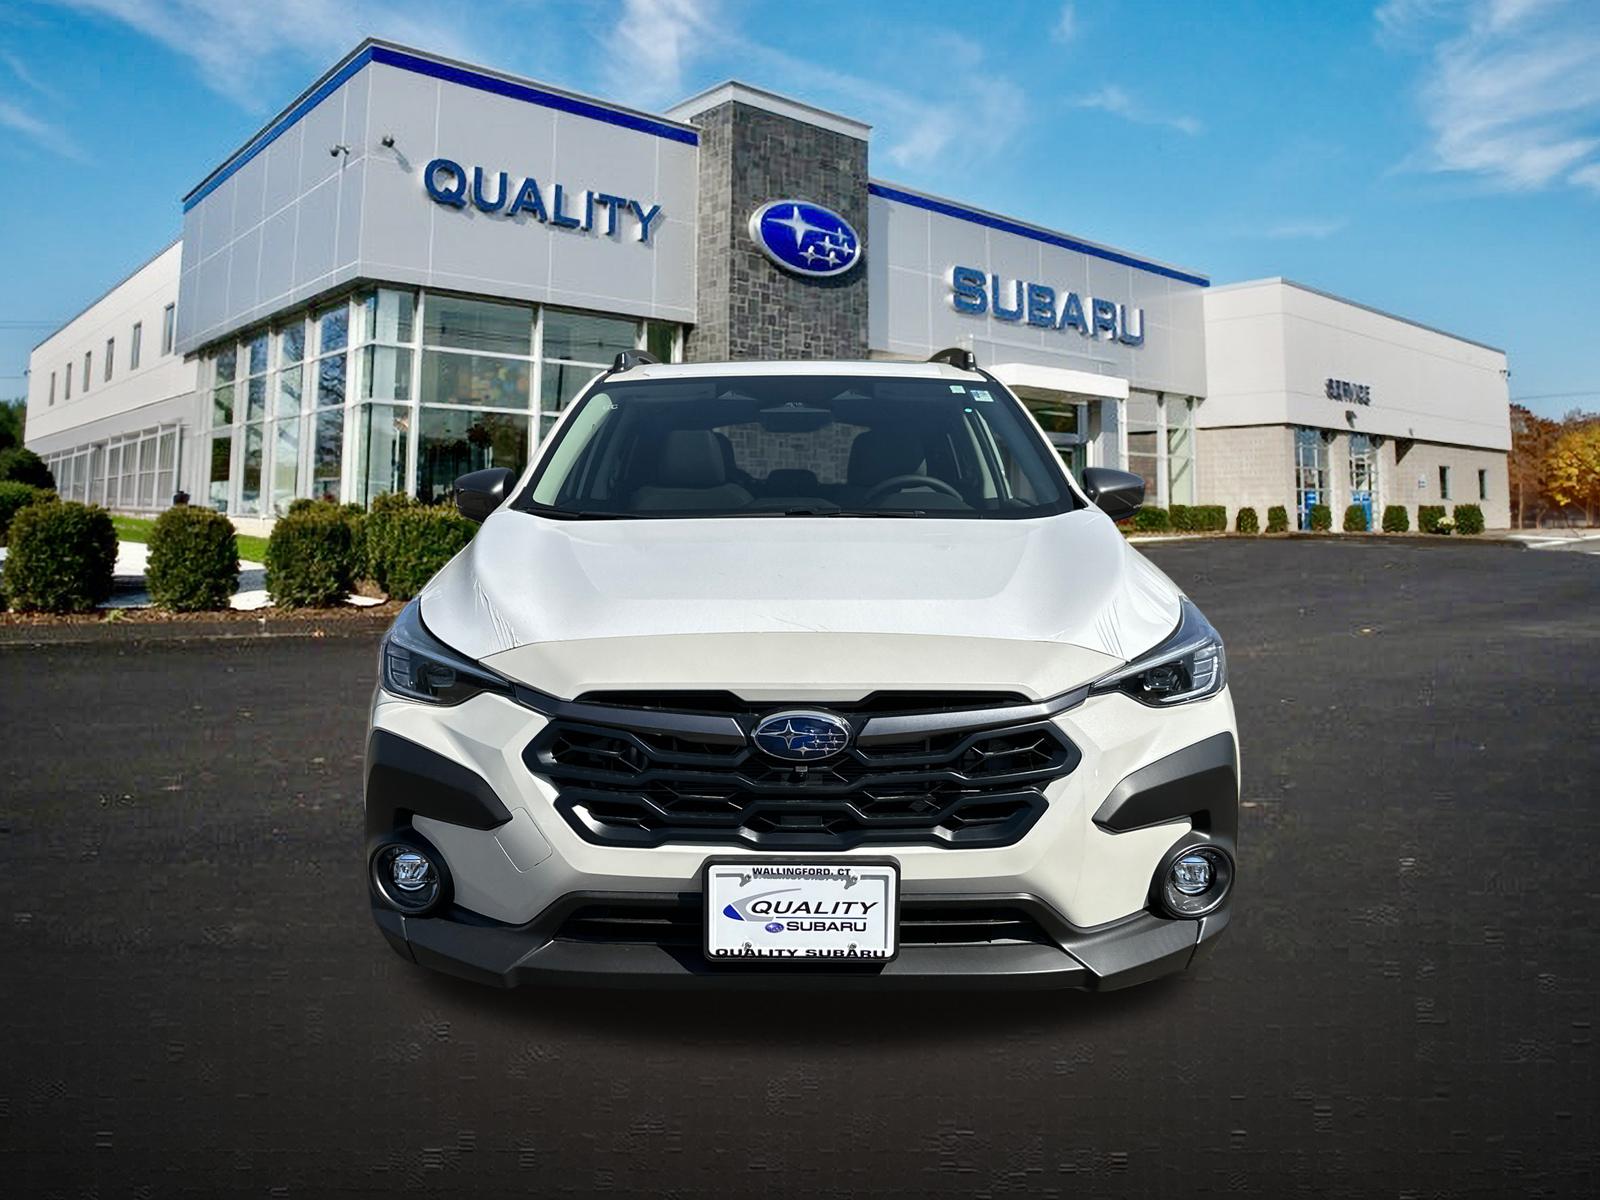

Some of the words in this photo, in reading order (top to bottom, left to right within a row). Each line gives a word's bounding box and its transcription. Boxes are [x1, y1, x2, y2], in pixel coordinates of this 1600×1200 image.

[424, 158, 661, 243] QUALITY
[953, 265, 1145, 347] SUBARU
[837, 868, 851, 876] CT
[751, 900, 879, 915] QUALITY
[786, 921, 867, 932] SUBARU
[715, 948, 797, 958] QUALITY
[805, 949, 886, 958] SUBARU
